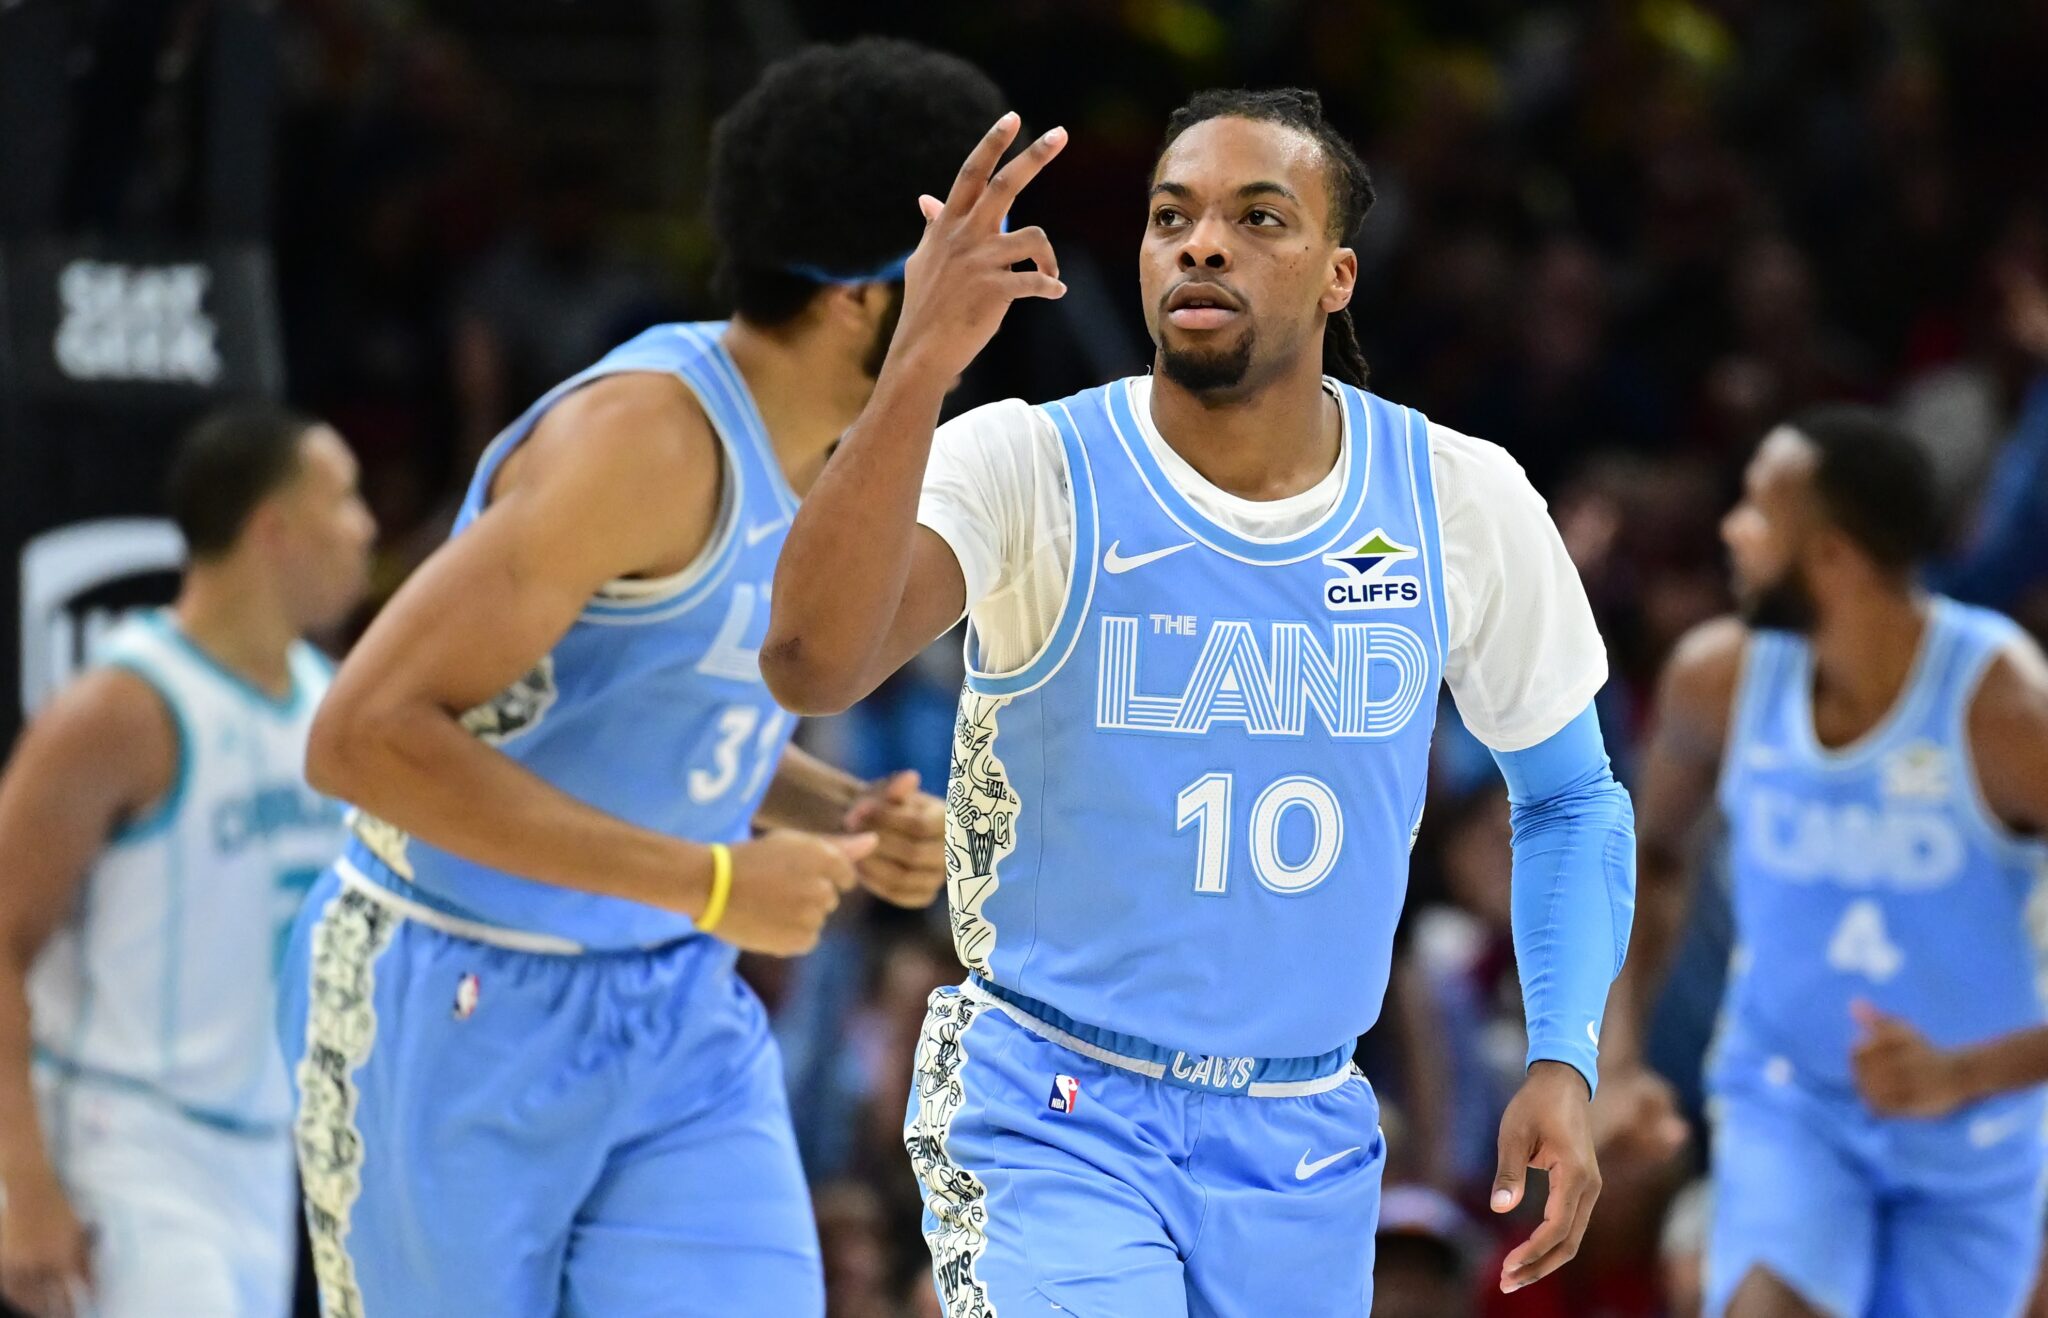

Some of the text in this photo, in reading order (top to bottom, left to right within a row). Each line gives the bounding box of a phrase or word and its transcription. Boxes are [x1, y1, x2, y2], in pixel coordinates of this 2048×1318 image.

[1326, 582, 1419, 604] CLIFFS
[1149, 613, 1198, 636] THE
[1096, 615, 1431, 738] LAND
[1176, 772, 1345, 895] 10
[1826, 898, 1904, 984] 4
[1171, 1050, 1256, 1089] CAVS
[1050, 1097, 1065, 1110] NBA
